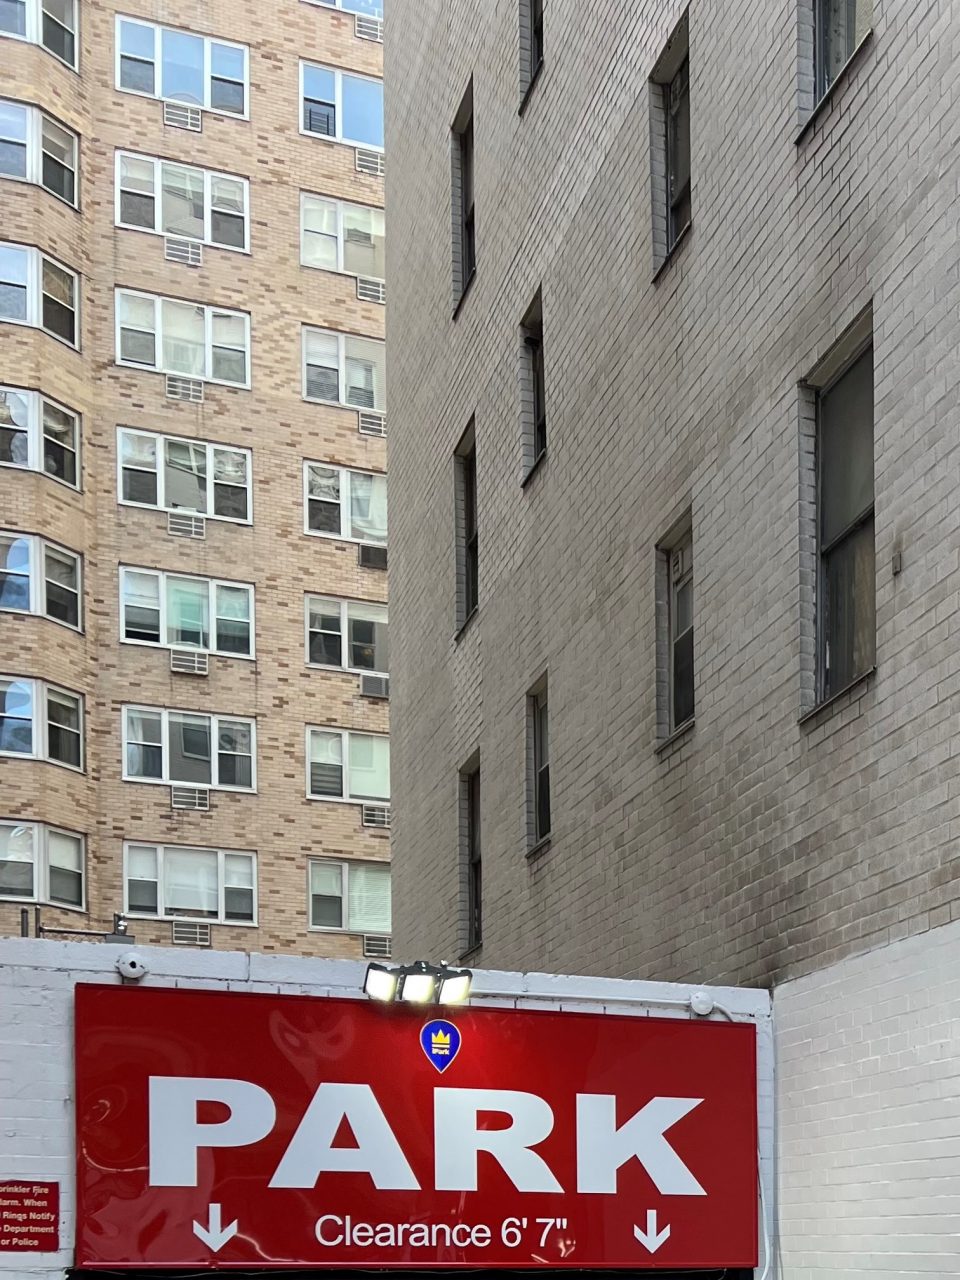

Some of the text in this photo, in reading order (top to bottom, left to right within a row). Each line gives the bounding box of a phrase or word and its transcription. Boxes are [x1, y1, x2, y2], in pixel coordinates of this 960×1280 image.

[148, 1076, 707, 1196] PARK
[32, 1186, 49, 1194] Fire
[23, 1199, 48, 1207] When
[2, 1211, 28, 1222] Rings
[29, 1212, 55, 1222] Notify
[3, 1225, 55, 1234] Department
[315, 1214, 568, 1248] Clearance 6' 7"
[12, 1238, 39, 1246] Police
